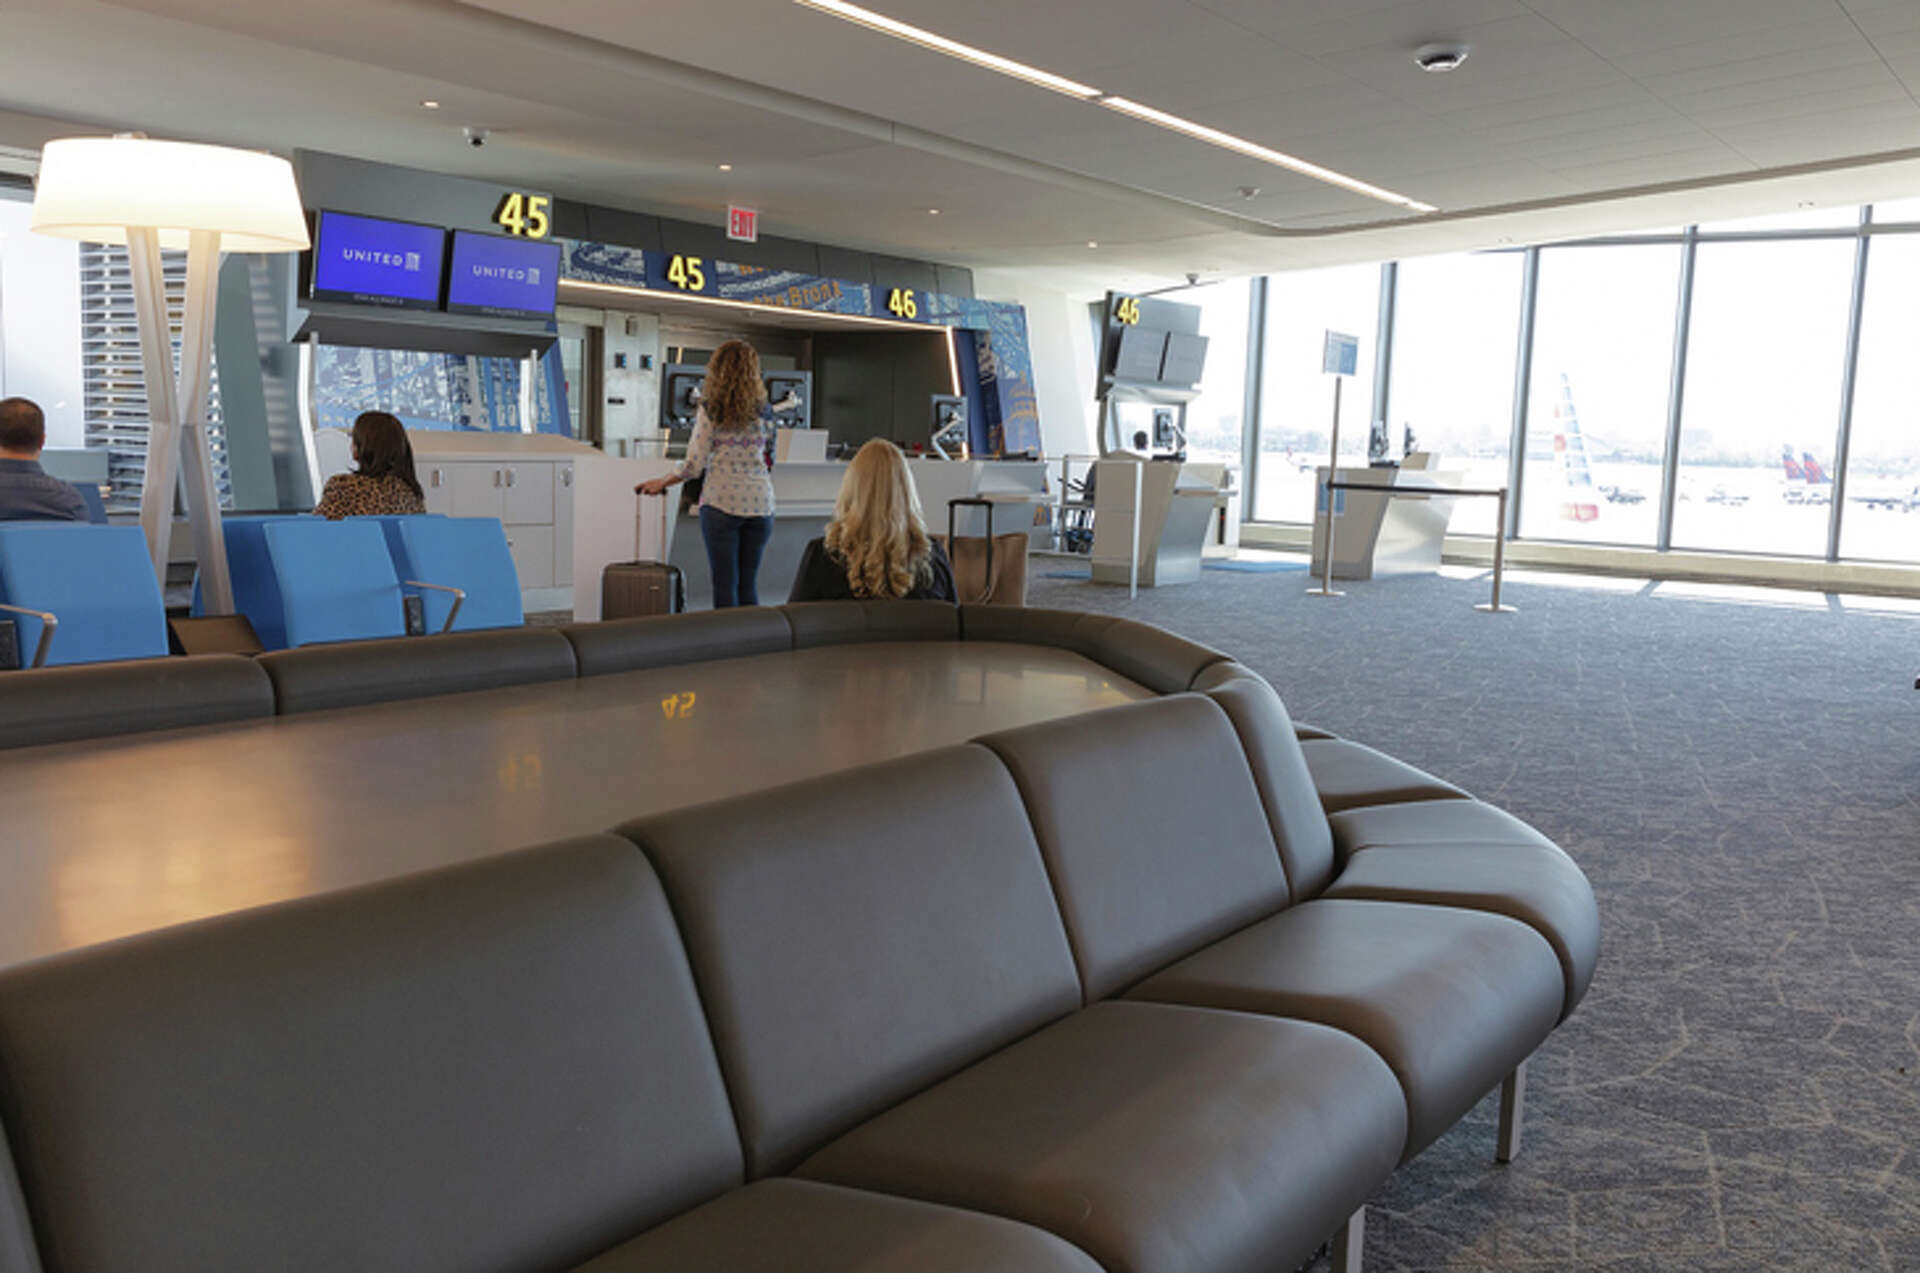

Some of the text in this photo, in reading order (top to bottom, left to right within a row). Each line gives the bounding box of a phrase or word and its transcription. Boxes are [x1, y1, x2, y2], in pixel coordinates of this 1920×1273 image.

[499, 192, 548, 239] 45
[730, 207, 756, 238] EXIT
[343, 248, 403, 267] UNITED
[473, 264, 525, 280] UNITED
[667, 254, 705, 291] 45
[788, 281, 843, 306] Bronx
[889, 288, 916, 319] 46
[1117, 297, 1140, 325] 46
